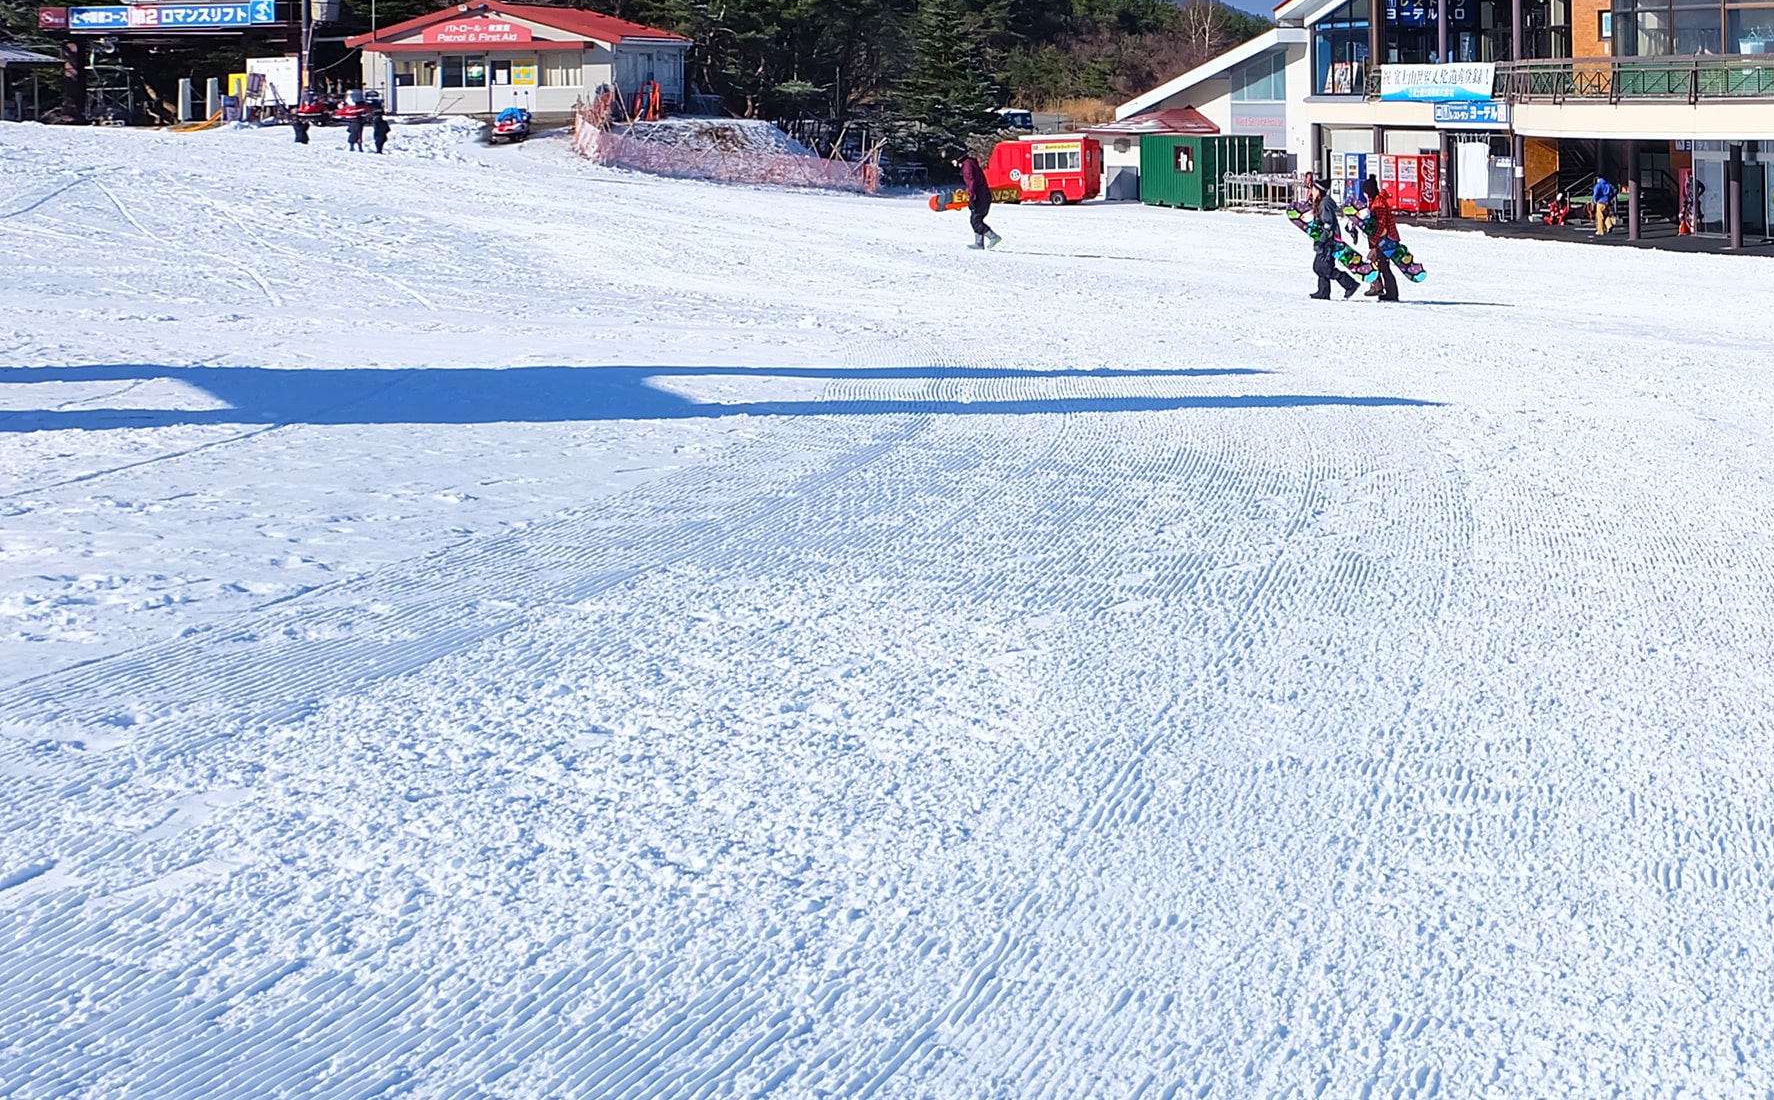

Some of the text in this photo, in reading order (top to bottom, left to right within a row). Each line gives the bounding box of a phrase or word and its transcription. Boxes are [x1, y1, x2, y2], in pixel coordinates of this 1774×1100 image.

[161, 7, 248, 23] ロマンスリフト
[1386, 8, 1465, 21] ヨーデル口
[437, 33, 518, 42] Patrol & First Aid
